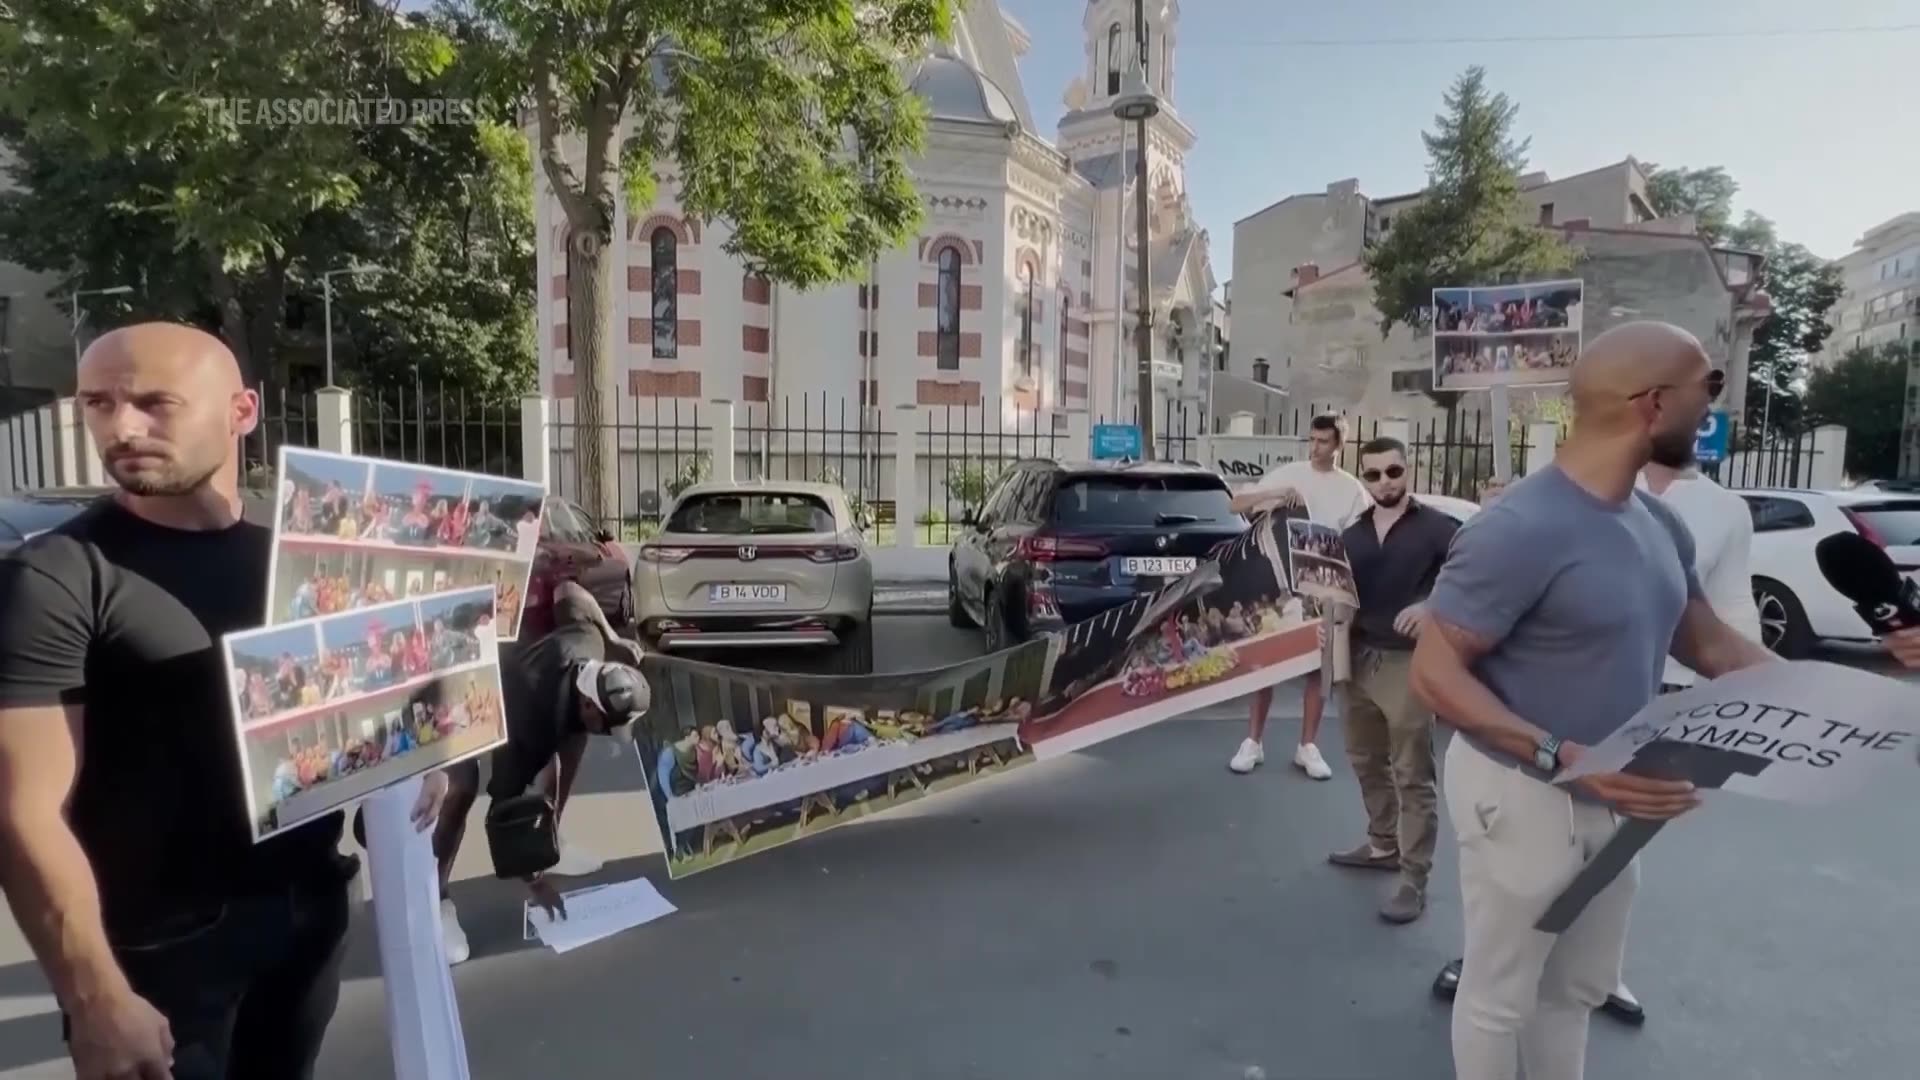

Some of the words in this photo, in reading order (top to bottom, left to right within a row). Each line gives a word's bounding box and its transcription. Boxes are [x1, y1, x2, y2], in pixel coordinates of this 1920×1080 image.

[1128, 560, 1138, 572] B
[1143, 560, 1162, 571] 123
[1168, 560, 1193, 572] TEK
[720, 586, 730, 598] B
[735, 586, 746, 598] 14
[1819, 719, 1913, 751] THE
